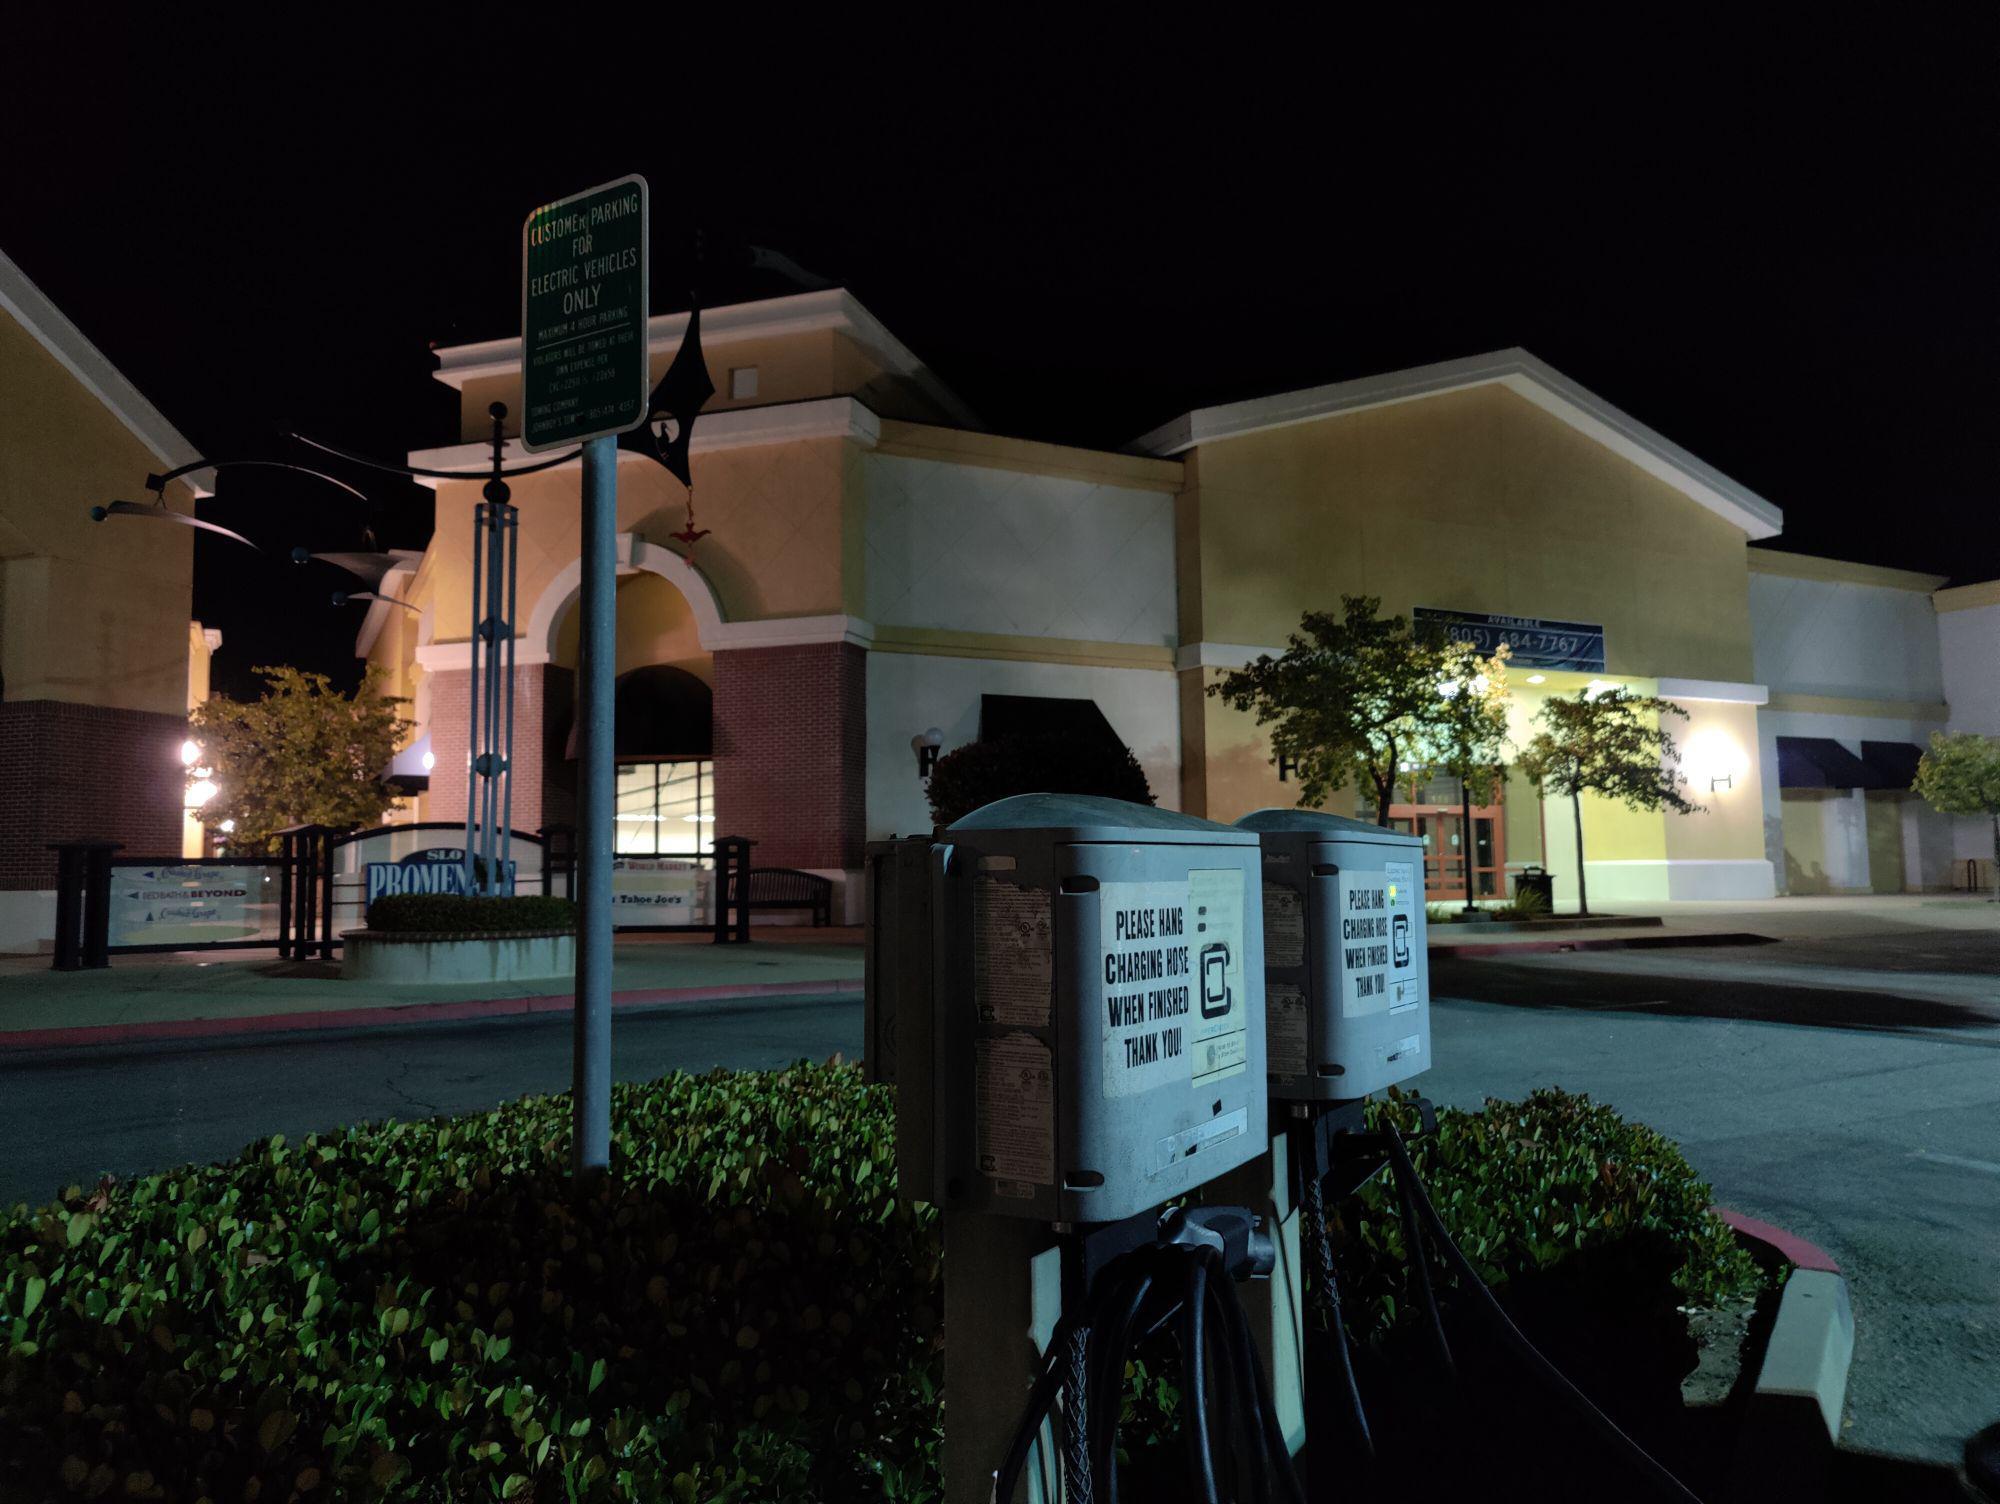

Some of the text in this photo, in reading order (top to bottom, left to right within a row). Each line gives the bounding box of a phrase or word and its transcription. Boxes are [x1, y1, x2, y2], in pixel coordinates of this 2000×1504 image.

[531, 194, 638, 247] CUSTOMER PARKING
[572, 234, 593, 258] FOR
[531, 247, 637, 297] ELECTRIC VEHICLES
[563, 283, 601, 315] ONLY
[600, 306, 629, 323] PARKING
[1488, 615, 1541, 628] AVAILABLE
[1443, 623, 1578, 653] (805) 684-7767
[427, 850, 463, 860] SLO
[191, 889, 245, 899] BEYOND
[369, 863, 514, 904] PROMEN
[620, 894, 682, 904] Tahoe Joe's
[1350, 889, 1370, 910] PLEASE
[1116, 906, 1183, 941] PLEASE HANG
[1343, 918, 1375, 940] CHARGING
[1105, 946, 1189, 985] CHARGING HOSE
[1345, 946, 1366, 970] WHEN
[1356, 974, 1373, 999] THANK
[1108, 986, 1189, 1027] WHEN FINISHED
[1124, 1032, 1158, 1069] THANK
[1162, 1026, 1182, 1059] YOU!
